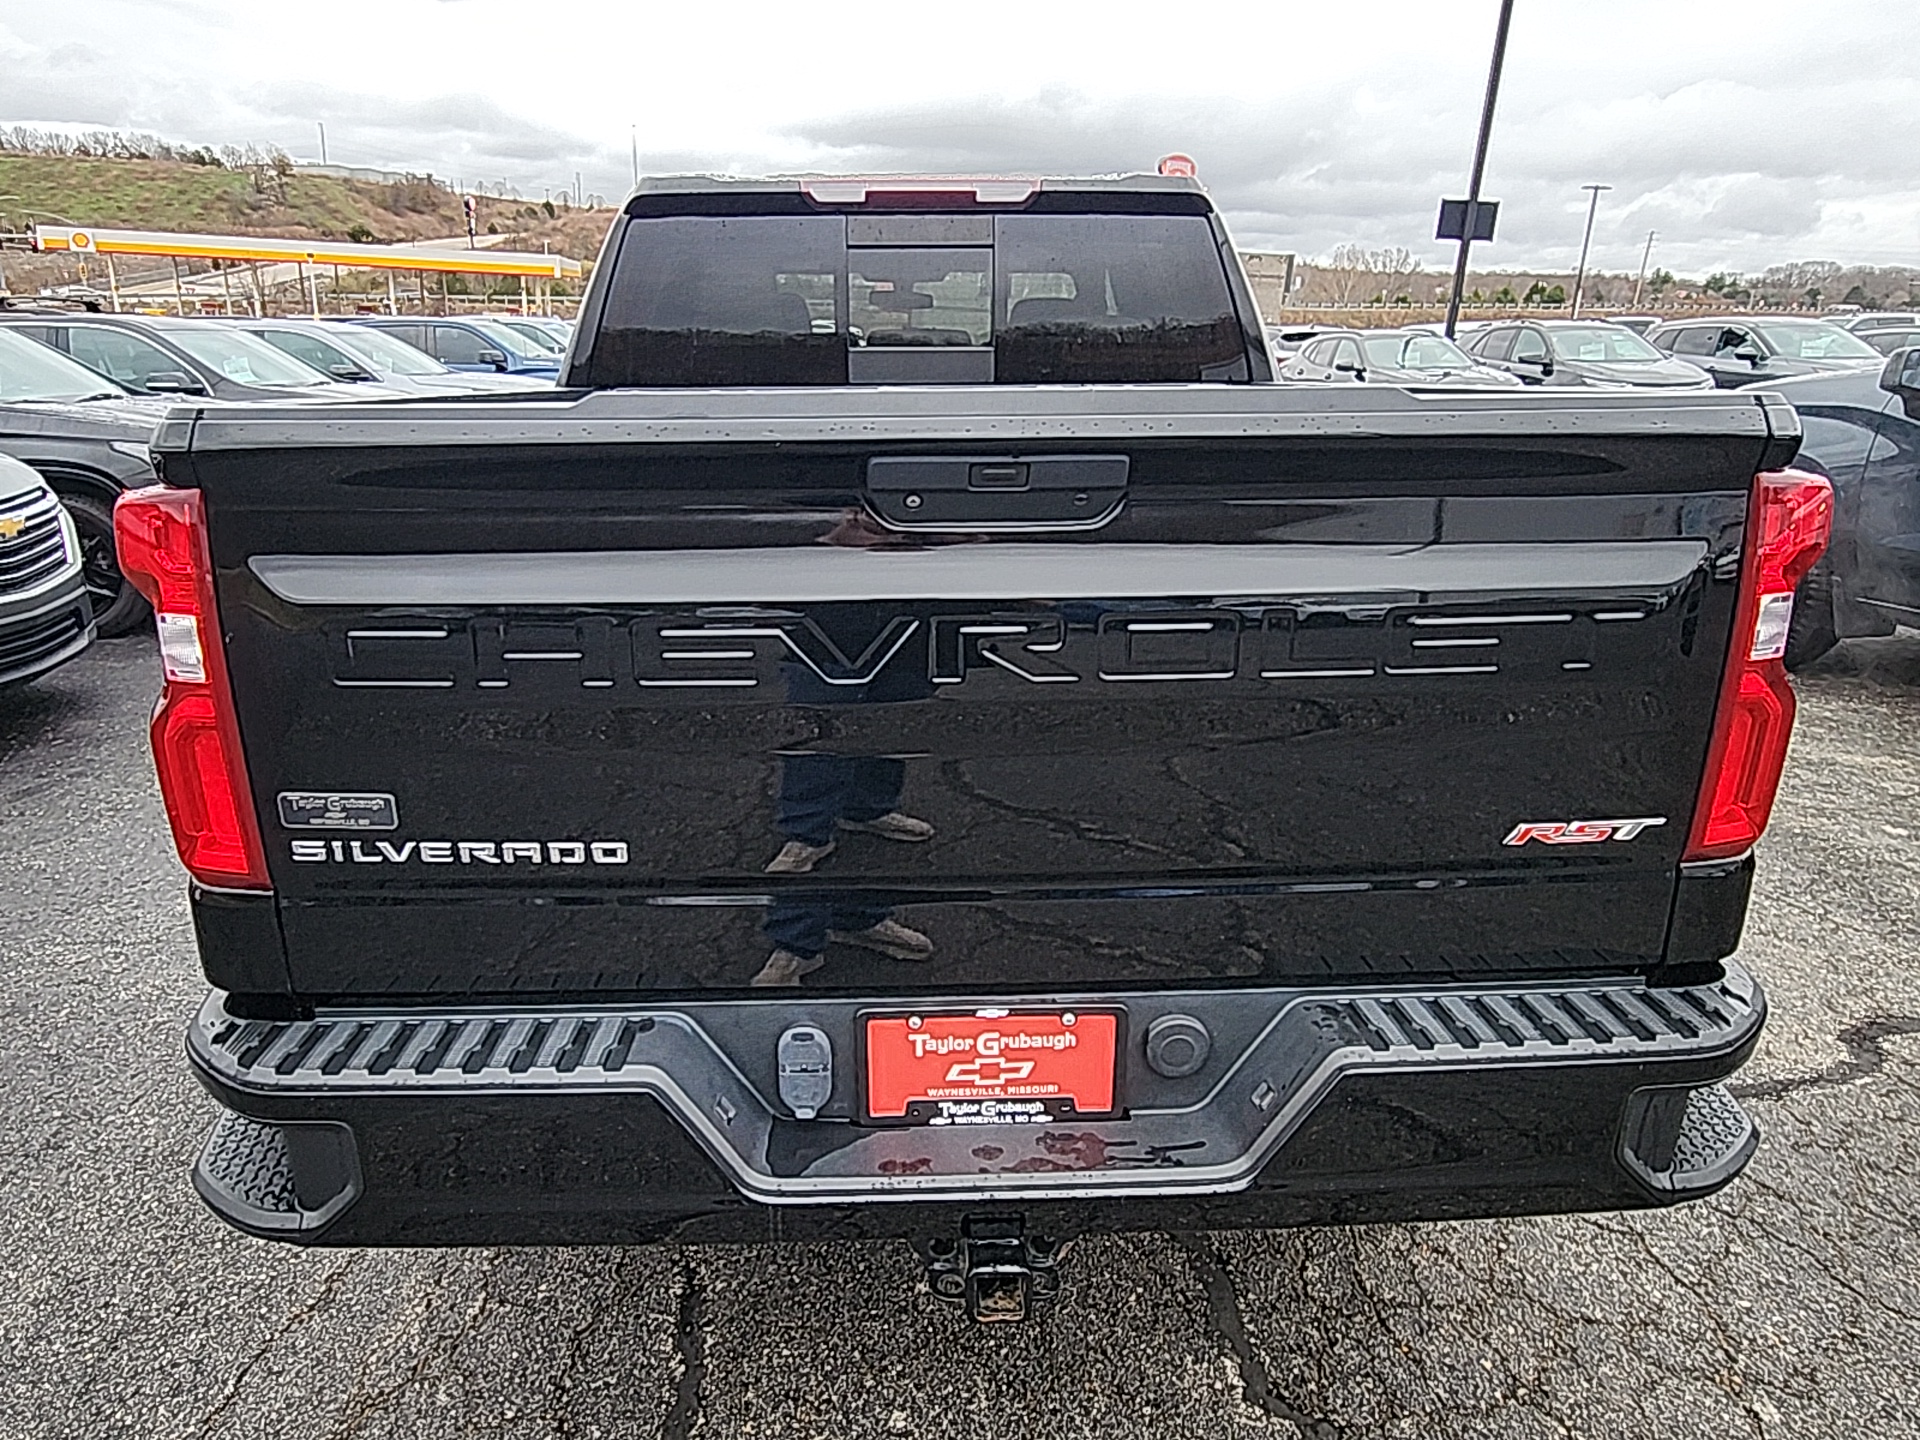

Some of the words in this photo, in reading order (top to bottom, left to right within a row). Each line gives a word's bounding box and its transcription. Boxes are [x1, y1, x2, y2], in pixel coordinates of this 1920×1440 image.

[328, 607, 1648, 689] CHEVROLET
[1502, 817, 1667, 845] RST
[291, 840, 629, 864] SILVERADO
[908, 1033, 974, 1057] Taylor
[976, 1032, 1076, 1055] Grubaugh
[927, 1086, 1004, 1097] WAYNESVILLE,
[1007, 1085, 1058, 1094] MISSOURI
[938, 1102, 980, 1117] Taylor
[981, 1101, 1045, 1116] Grubaugh
